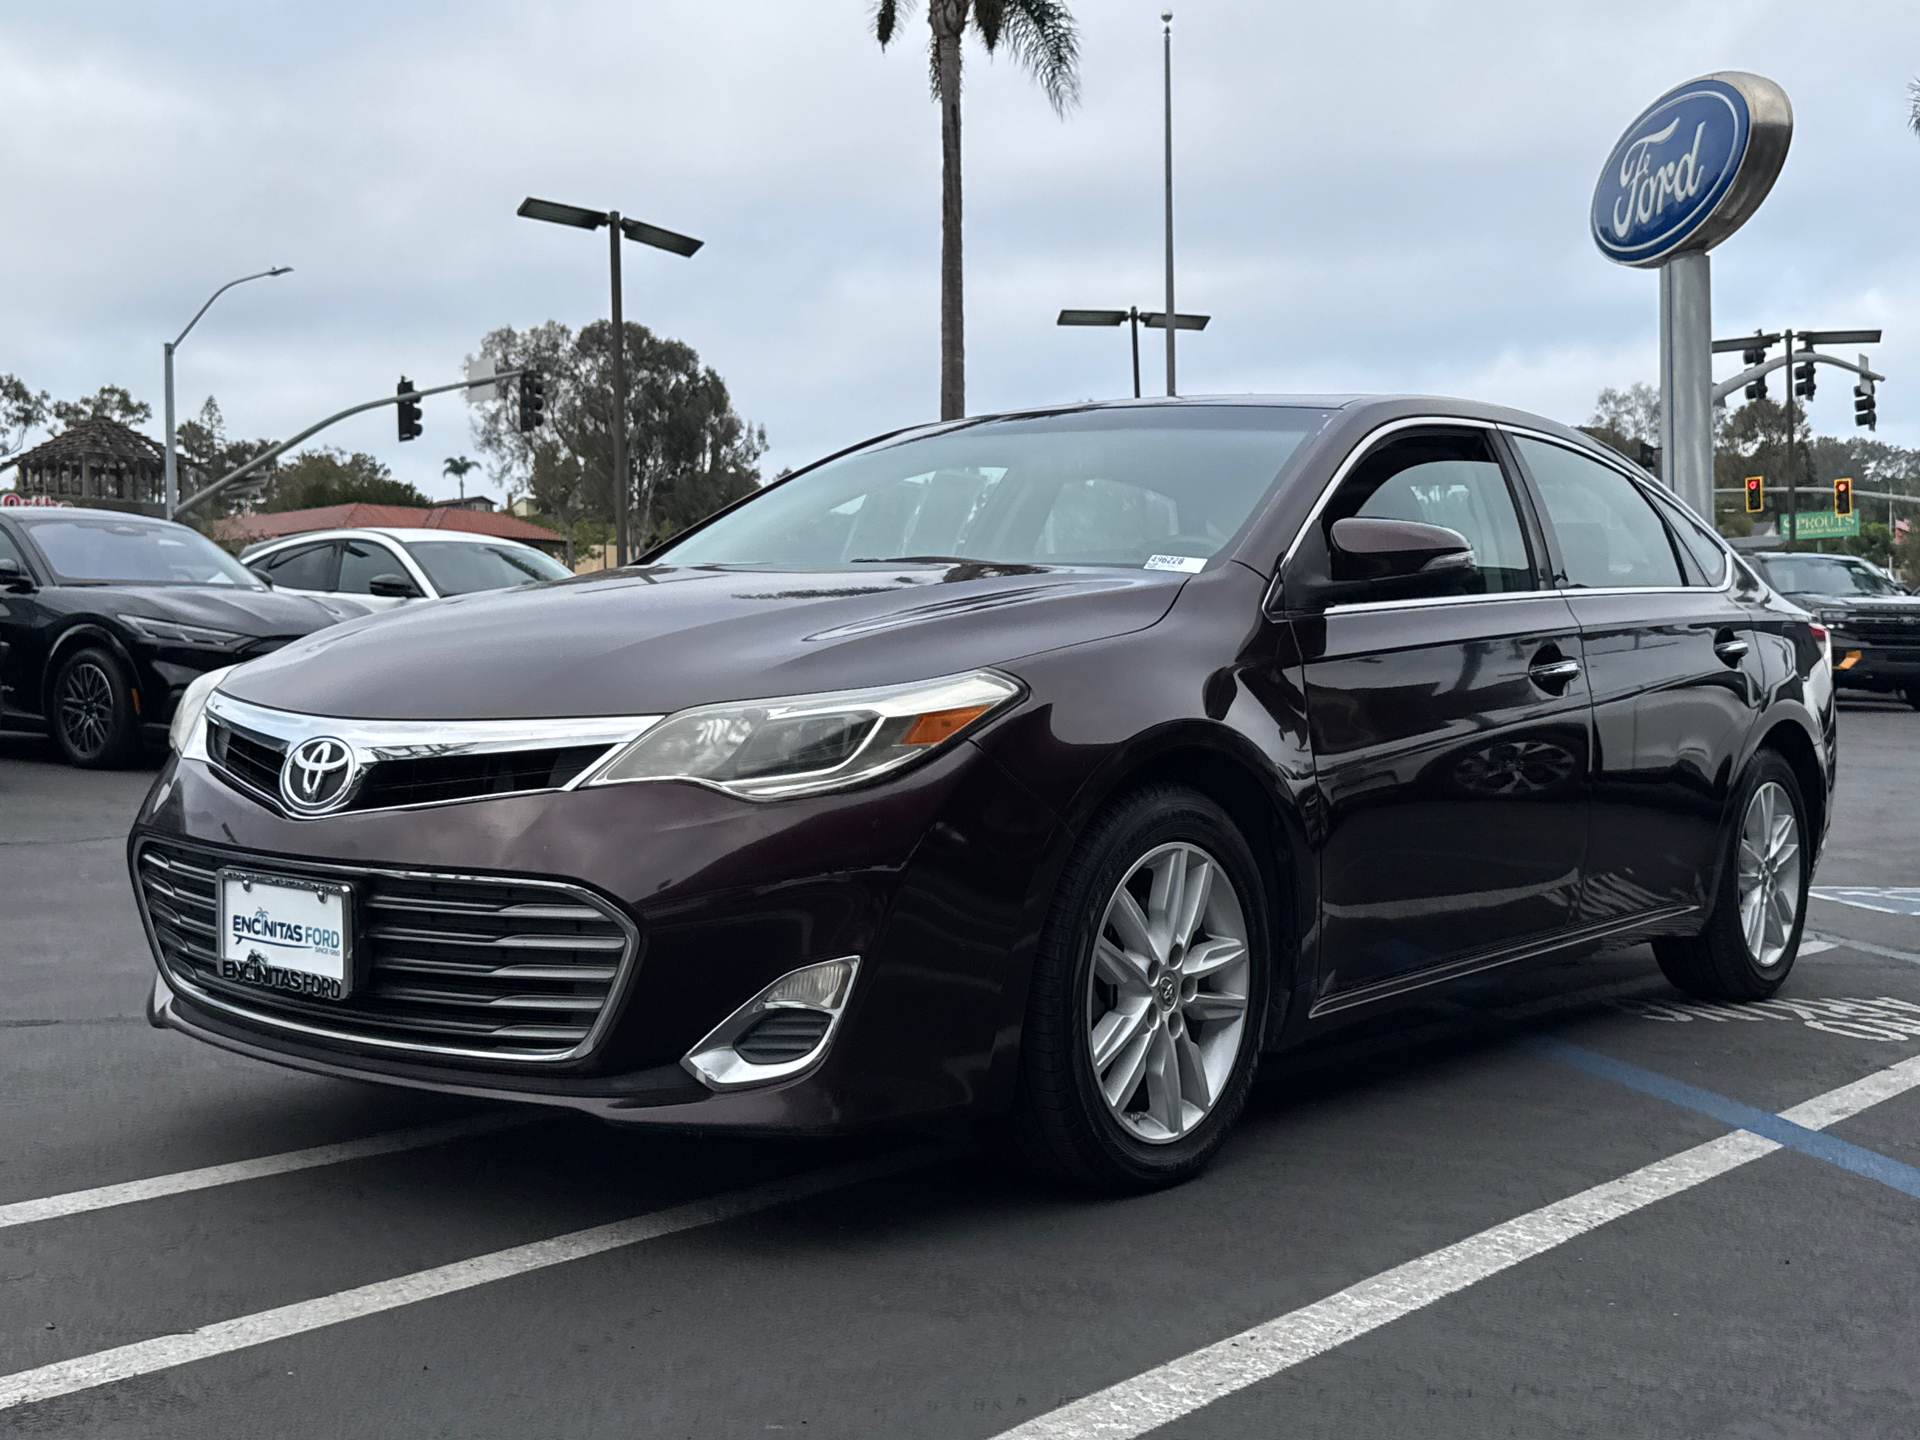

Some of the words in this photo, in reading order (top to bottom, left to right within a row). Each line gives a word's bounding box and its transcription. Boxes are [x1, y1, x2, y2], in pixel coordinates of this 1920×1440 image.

[1613, 117, 1706, 238] Ford
[233, 911, 303, 942] ENCINITAS
[305, 926, 340, 949] FORD
[314, 946, 329, 955] SINCE
[222, 958, 302, 992] ENCINITAS
[302, 972, 342, 1000] FORD
